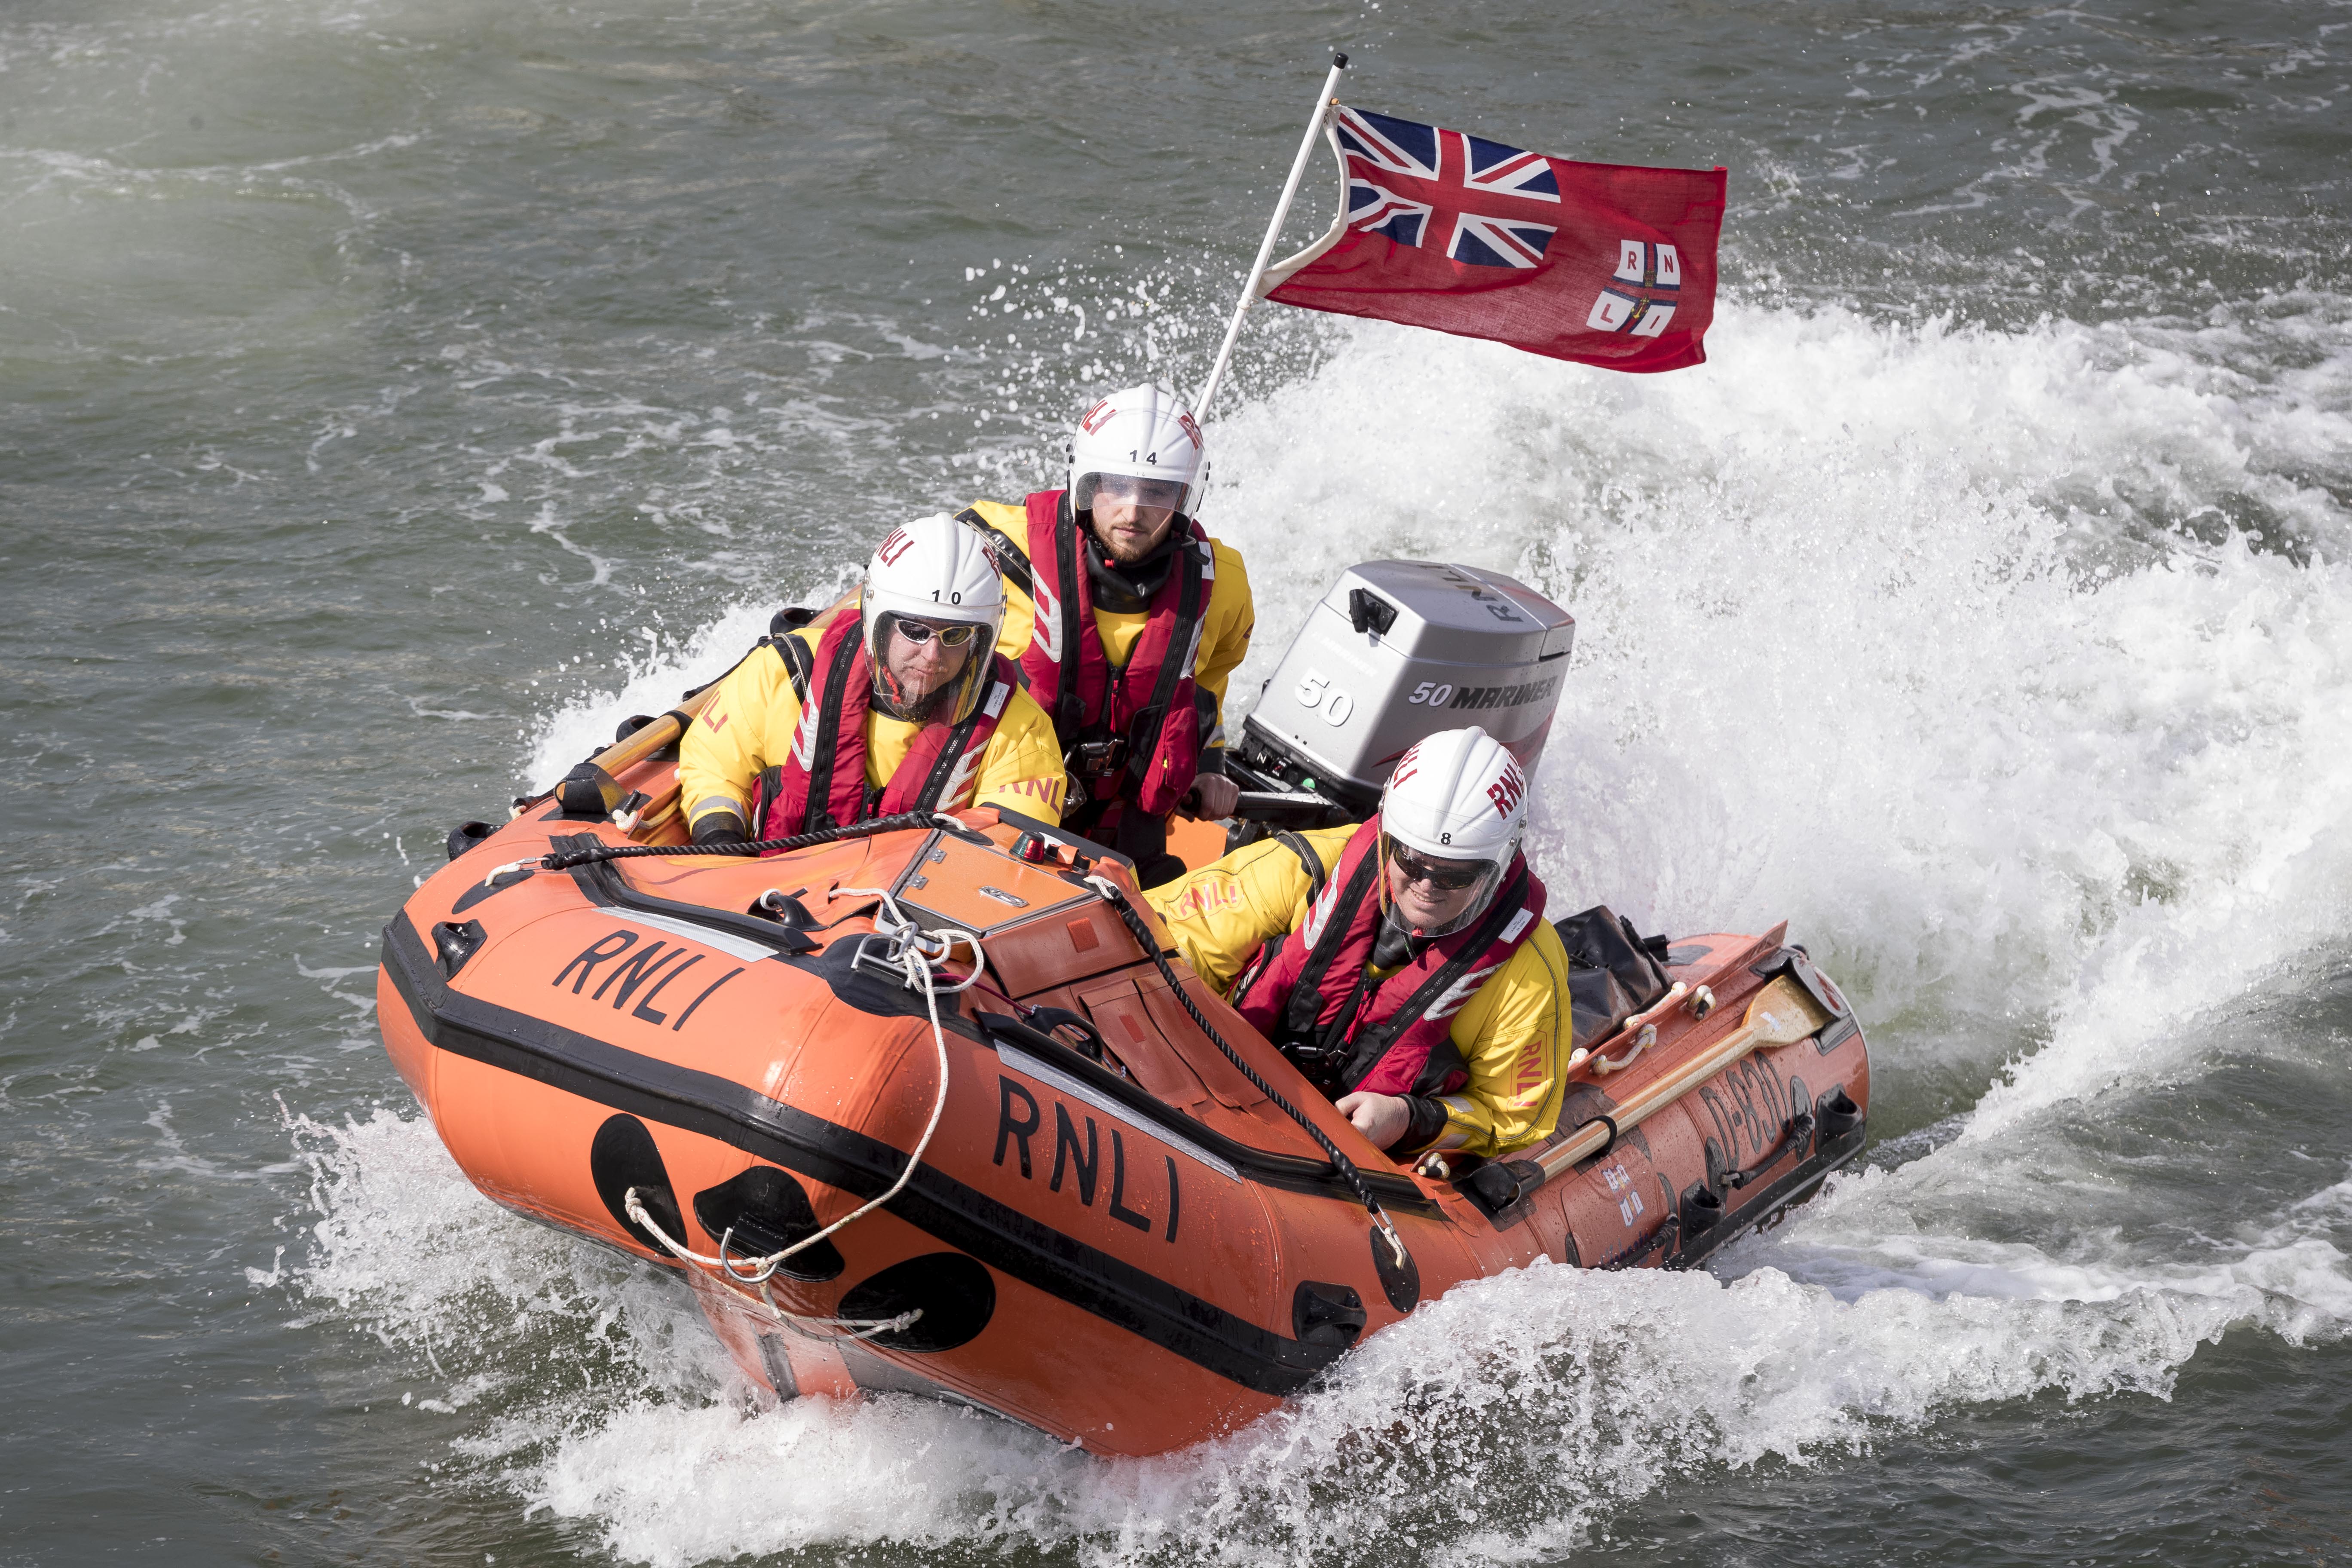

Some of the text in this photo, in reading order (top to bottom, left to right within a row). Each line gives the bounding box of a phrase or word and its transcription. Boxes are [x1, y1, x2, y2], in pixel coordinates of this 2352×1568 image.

[1627, 251, 1674, 273] R N
[1600, 303, 1614, 324] L
[1130, 450, 1157, 465] 14
[932, 589, 962, 605] 10
[1295, 666, 1354, 727] 50
[1408, 675, 1558, 709] 50 MARINER
[1440, 832, 1452, 845] 8
[1179, 881, 1237, 917] RNLI
[552, 929, 746, 1032] RNLI
[1513, 1039, 1543, 1107] RNLI
[1698, 1050, 1790, 1172] D-830
[992, 1074, 1179, 1243] RNLI
